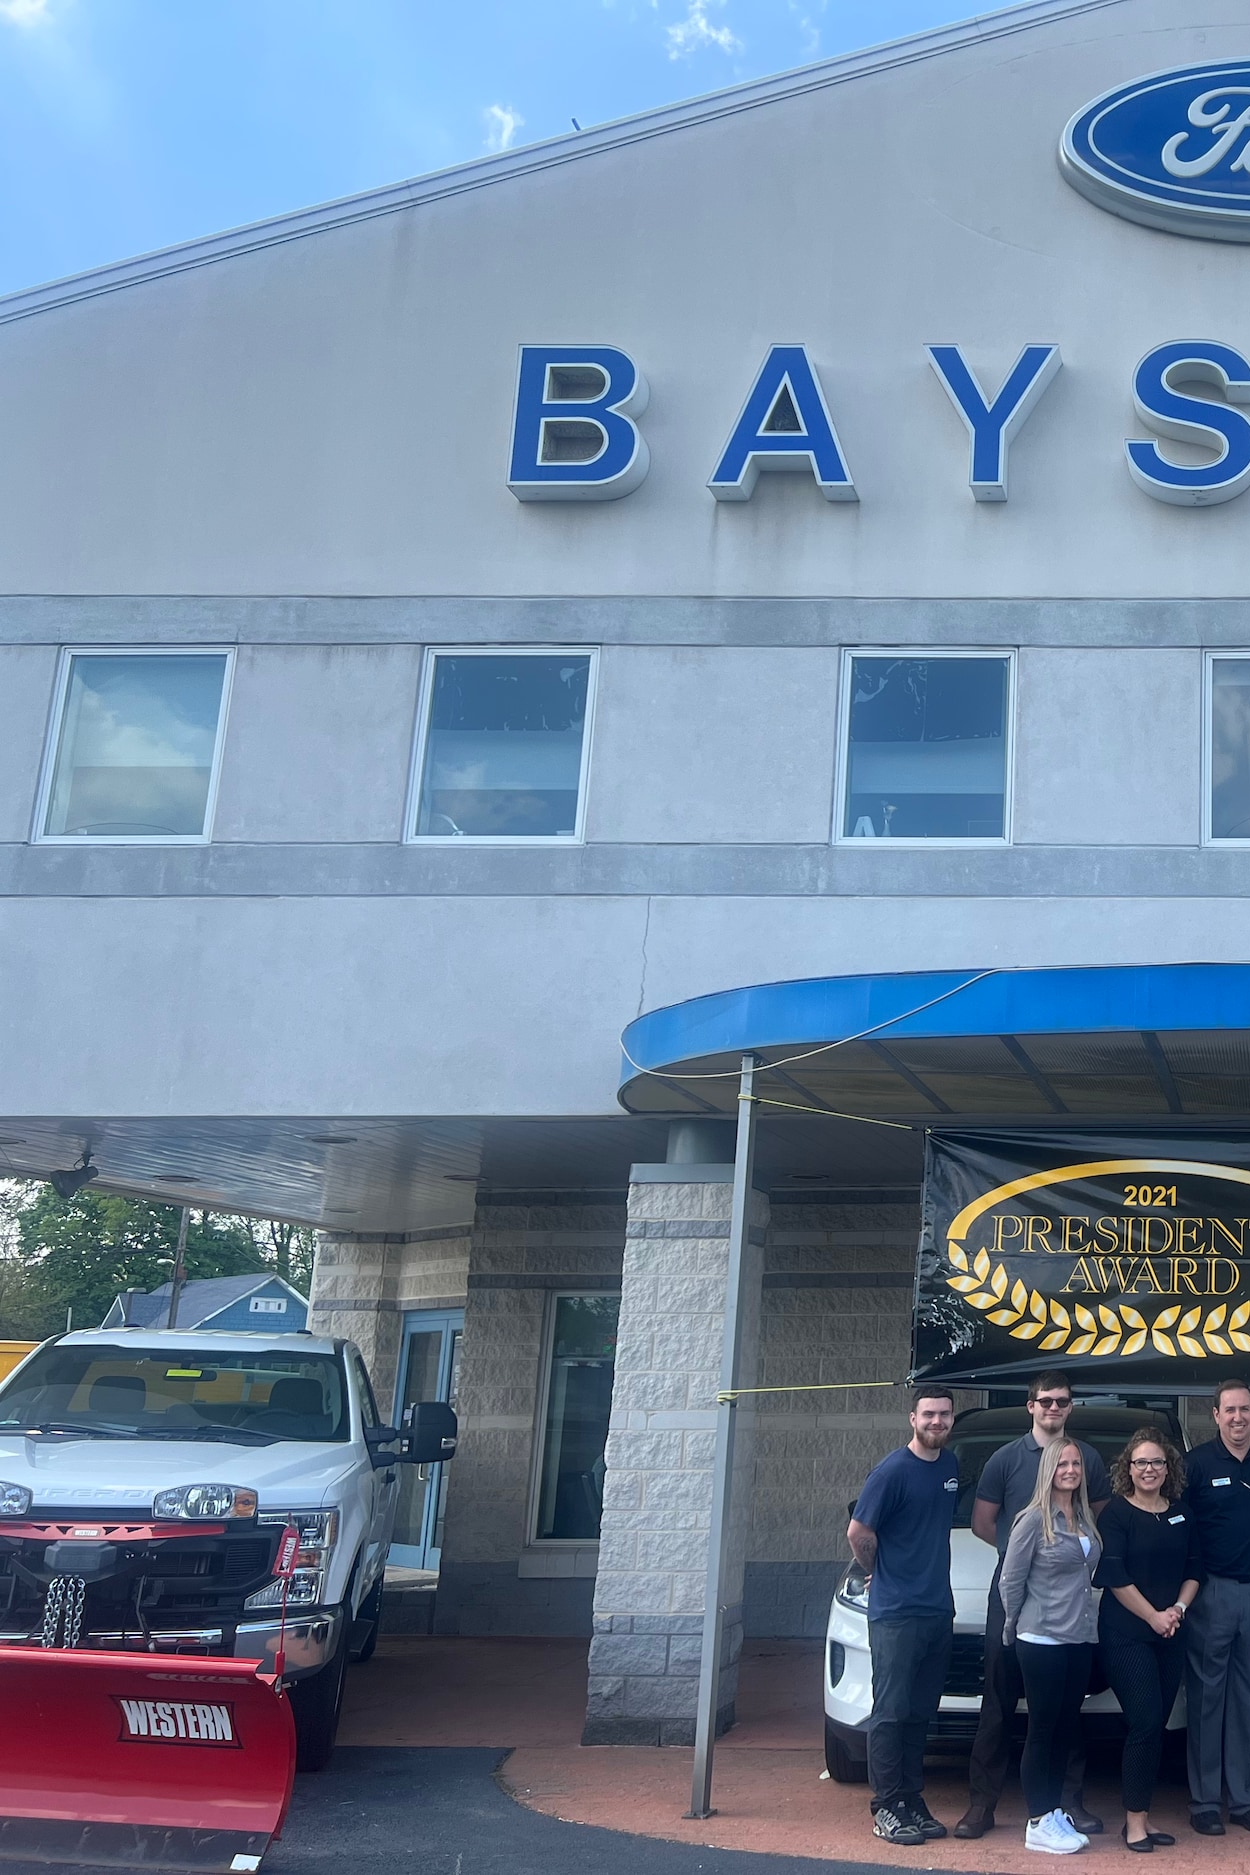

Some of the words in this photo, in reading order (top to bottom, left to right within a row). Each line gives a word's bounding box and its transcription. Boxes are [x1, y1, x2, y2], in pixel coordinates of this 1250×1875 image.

[1123, 1185, 1178, 1207] 2021
[1059, 1255, 1241, 1296] AWARD
[33, 1487, 117, 1498] UPER
[120, 1699, 233, 1741] WESTERN
